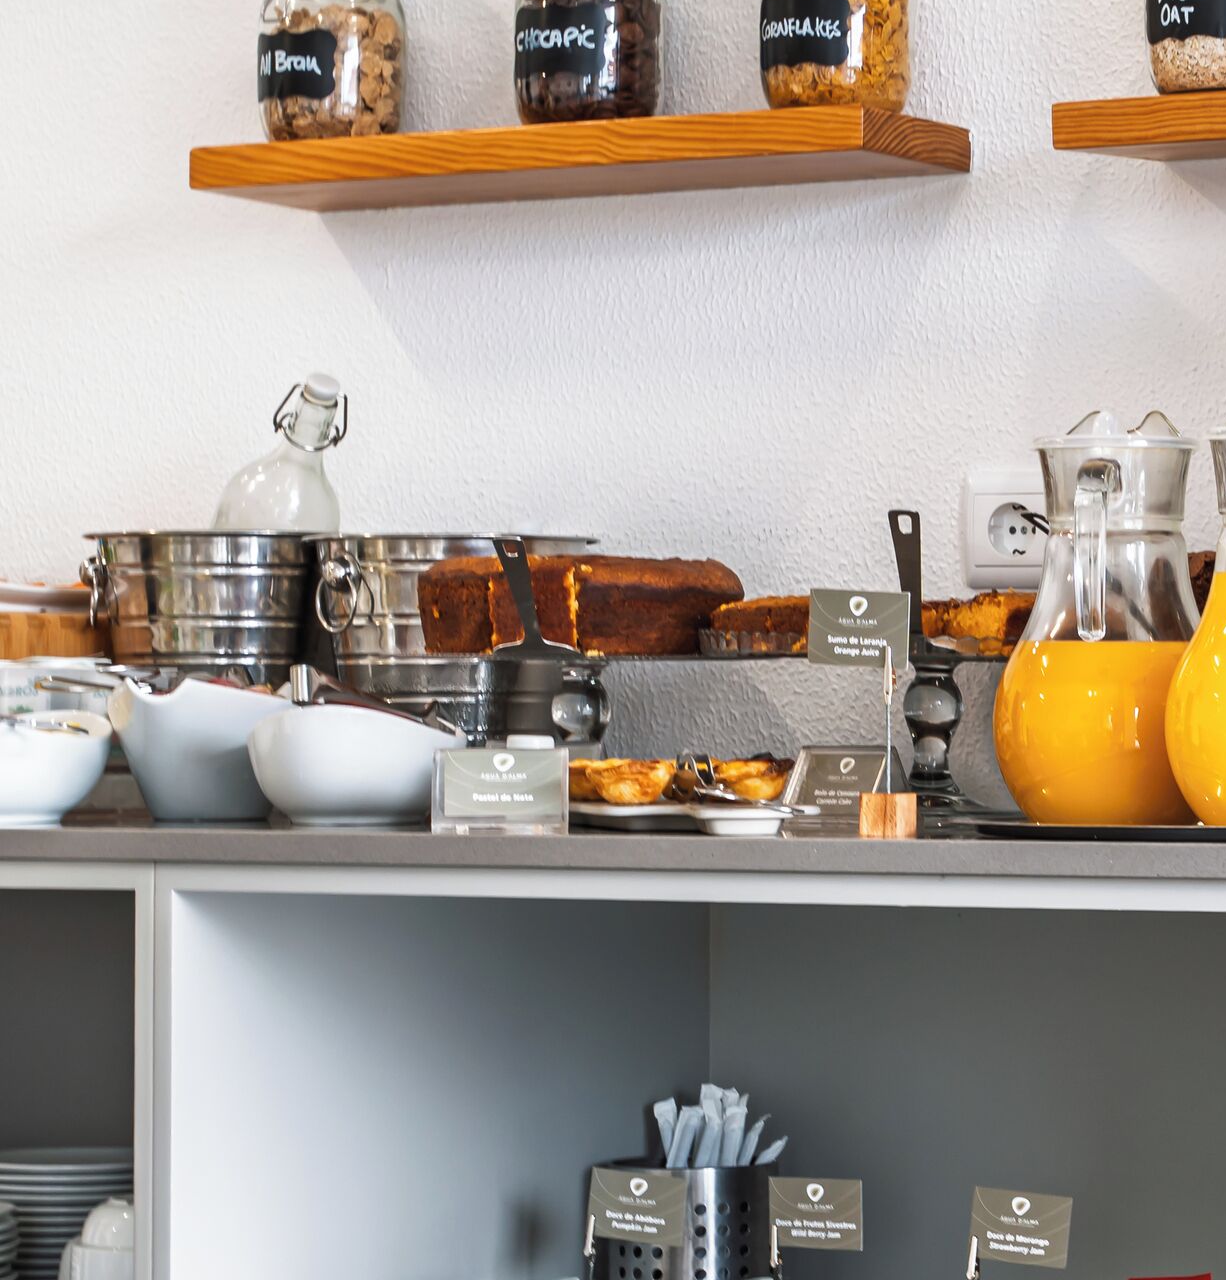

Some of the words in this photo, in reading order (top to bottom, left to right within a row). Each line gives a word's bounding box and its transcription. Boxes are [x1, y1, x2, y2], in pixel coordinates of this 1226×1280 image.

[1160, 3, 1195, 27] OAT
[274, 50, 322, 76] Bran
[827, 634, 848, 644] Sumo
[848, 635, 859, 645] de
[860, 636, 887, 648] Laranja
[833, 645, 860, 657] Orange
[860, 646, 880, 657] Juice
[472, 792, 499, 802] Pastel
[513, 792, 534, 802] Nata
[793, 1218, 803, 1228] de
[986, 1230, 1005, 1241] Doce
[1005, 1232, 1015, 1242] de
[1015, 1233, 1050, 1247] Morango
